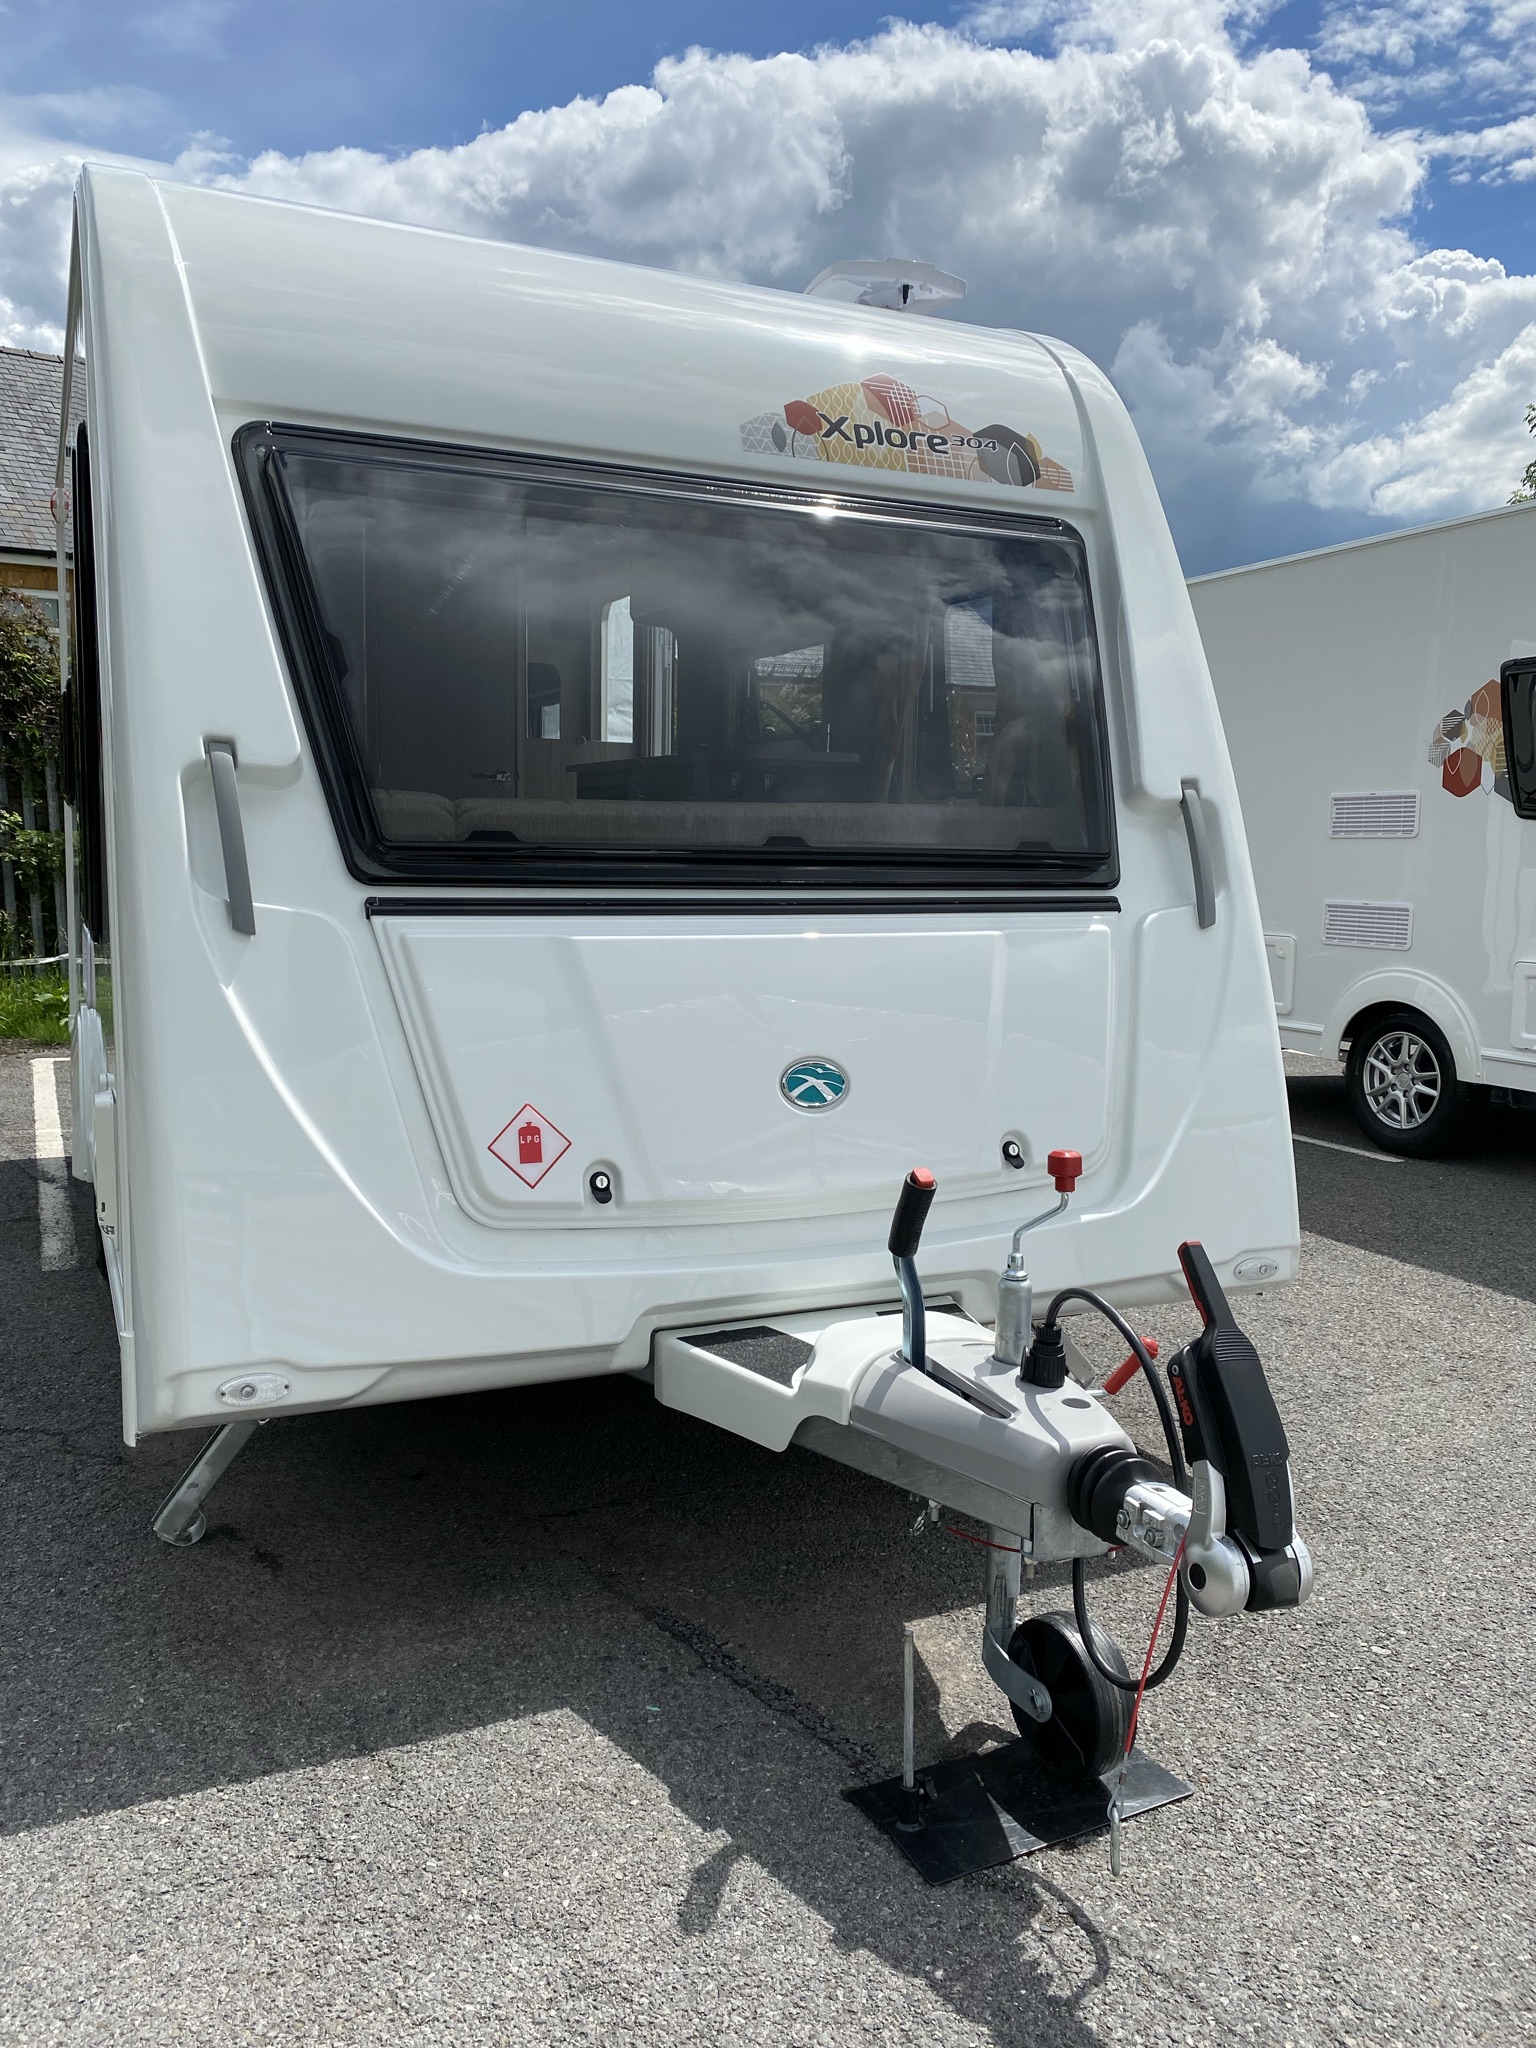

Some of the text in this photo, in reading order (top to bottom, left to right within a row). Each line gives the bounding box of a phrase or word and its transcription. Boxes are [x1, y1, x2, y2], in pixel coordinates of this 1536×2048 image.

[816, 412, 998, 455] Xplore 304
[520, 1135, 540, 1144] LPG
[1171, 1376, 1194, 1426] AL-KO
